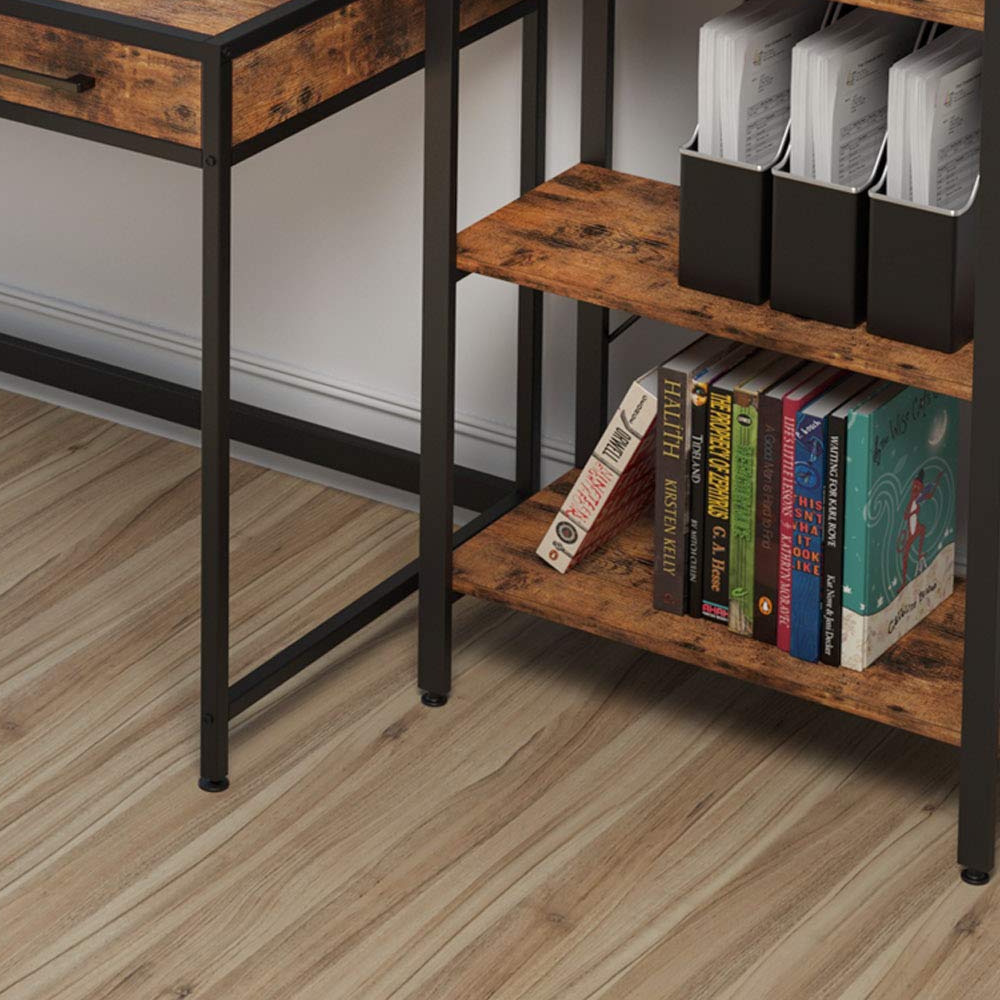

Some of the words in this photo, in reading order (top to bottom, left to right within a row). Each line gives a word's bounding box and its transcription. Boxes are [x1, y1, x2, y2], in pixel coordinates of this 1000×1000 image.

[711, 392, 732, 413] THE
[602, 427, 631, 462] ORWELL
[709, 410, 731, 460] PROPHECY
[691, 433, 704, 484] TIDELAND
[764, 435, 774, 460] Good
[829, 436, 838, 478] WAITING
[709, 458, 730, 476] OF
[707, 471, 730, 520] ZEPHYRUS
[829, 479, 838, 499] FOR
[663, 478, 678, 536] KIRSTEN
[793, 495, 823, 511] HIS
[828, 499, 838, 521] KARL
[794, 508, 823, 524] SN'T
[711, 525, 727, 539] G.
[797, 534, 811, 547] IT
[827, 522, 838, 548] ROVE
[663, 537, 676, 577] KELLY
[711, 541, 726, 555] A.
[711, 558, 725, 592] Hesse
[793, 560, 820, 576] IKE
